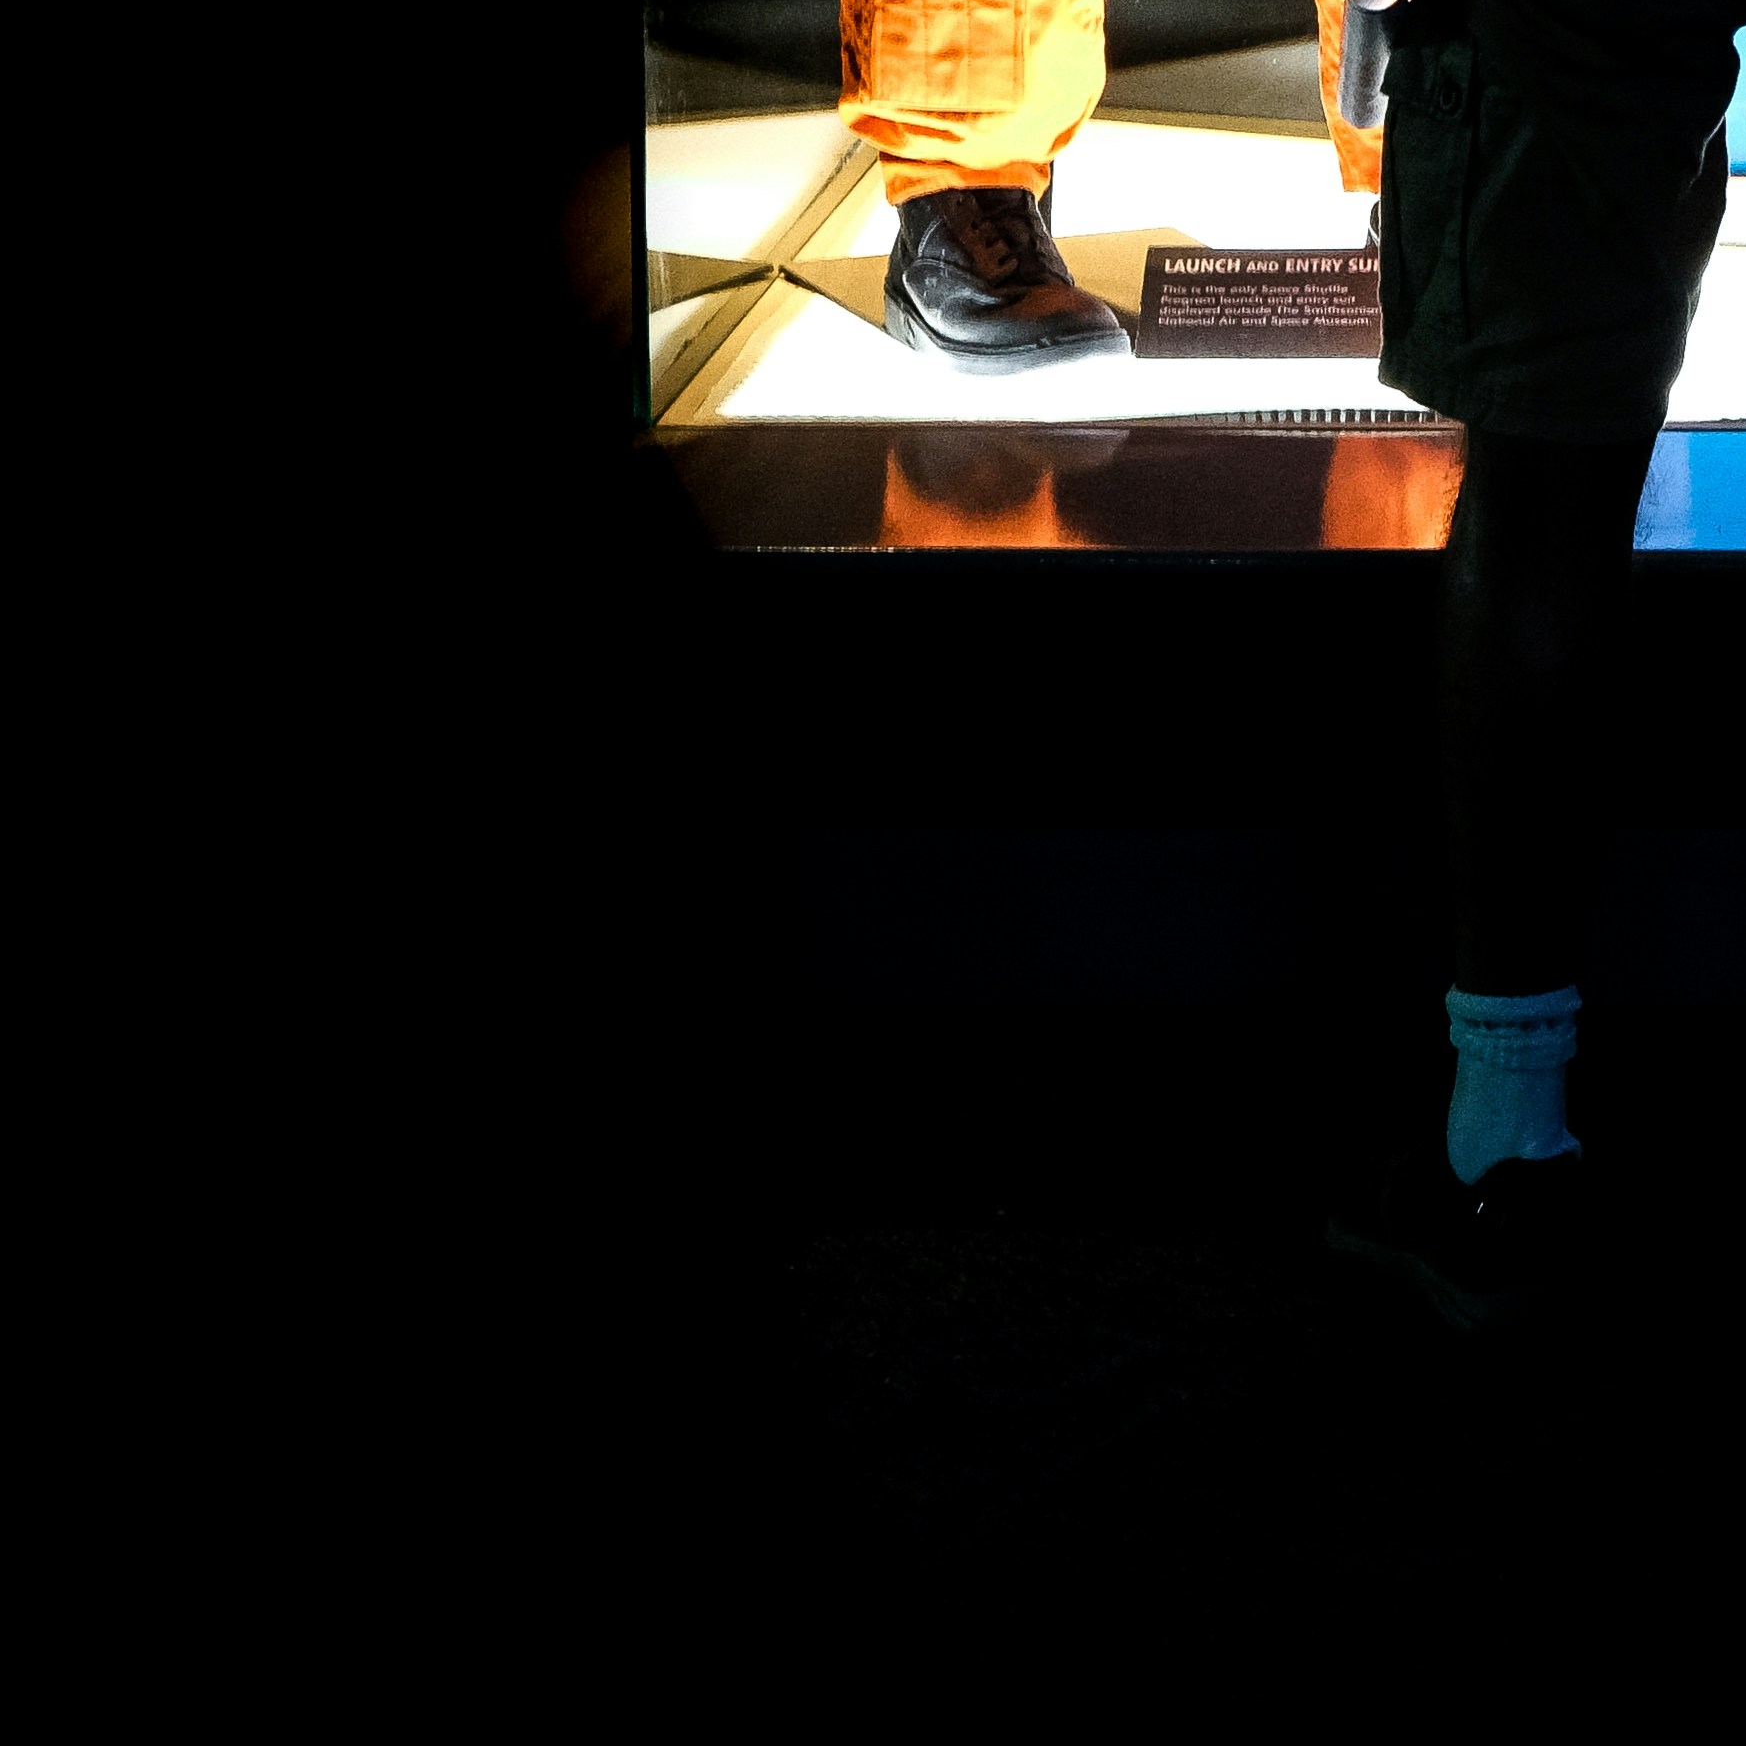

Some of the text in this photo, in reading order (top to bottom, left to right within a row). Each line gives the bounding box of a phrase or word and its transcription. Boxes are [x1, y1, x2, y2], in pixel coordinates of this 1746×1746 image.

[1164, 257, 1379, 274] LAUNCH AND ENTRY SUI
[1163, 284, 1187, 294] This
[1205, 284, 1226, 294] the
[1230, 285, 1257, 296] only
[1304, 284, 1349, 294] Shuttle
[1220, 295, 1263, 305] launch
[1267, 295, 1293, 305] and
[1296, 295, 1330, 306] entry
[1218, 316, 1238, 326] Air
[1241, 316, 1267, 326] and
